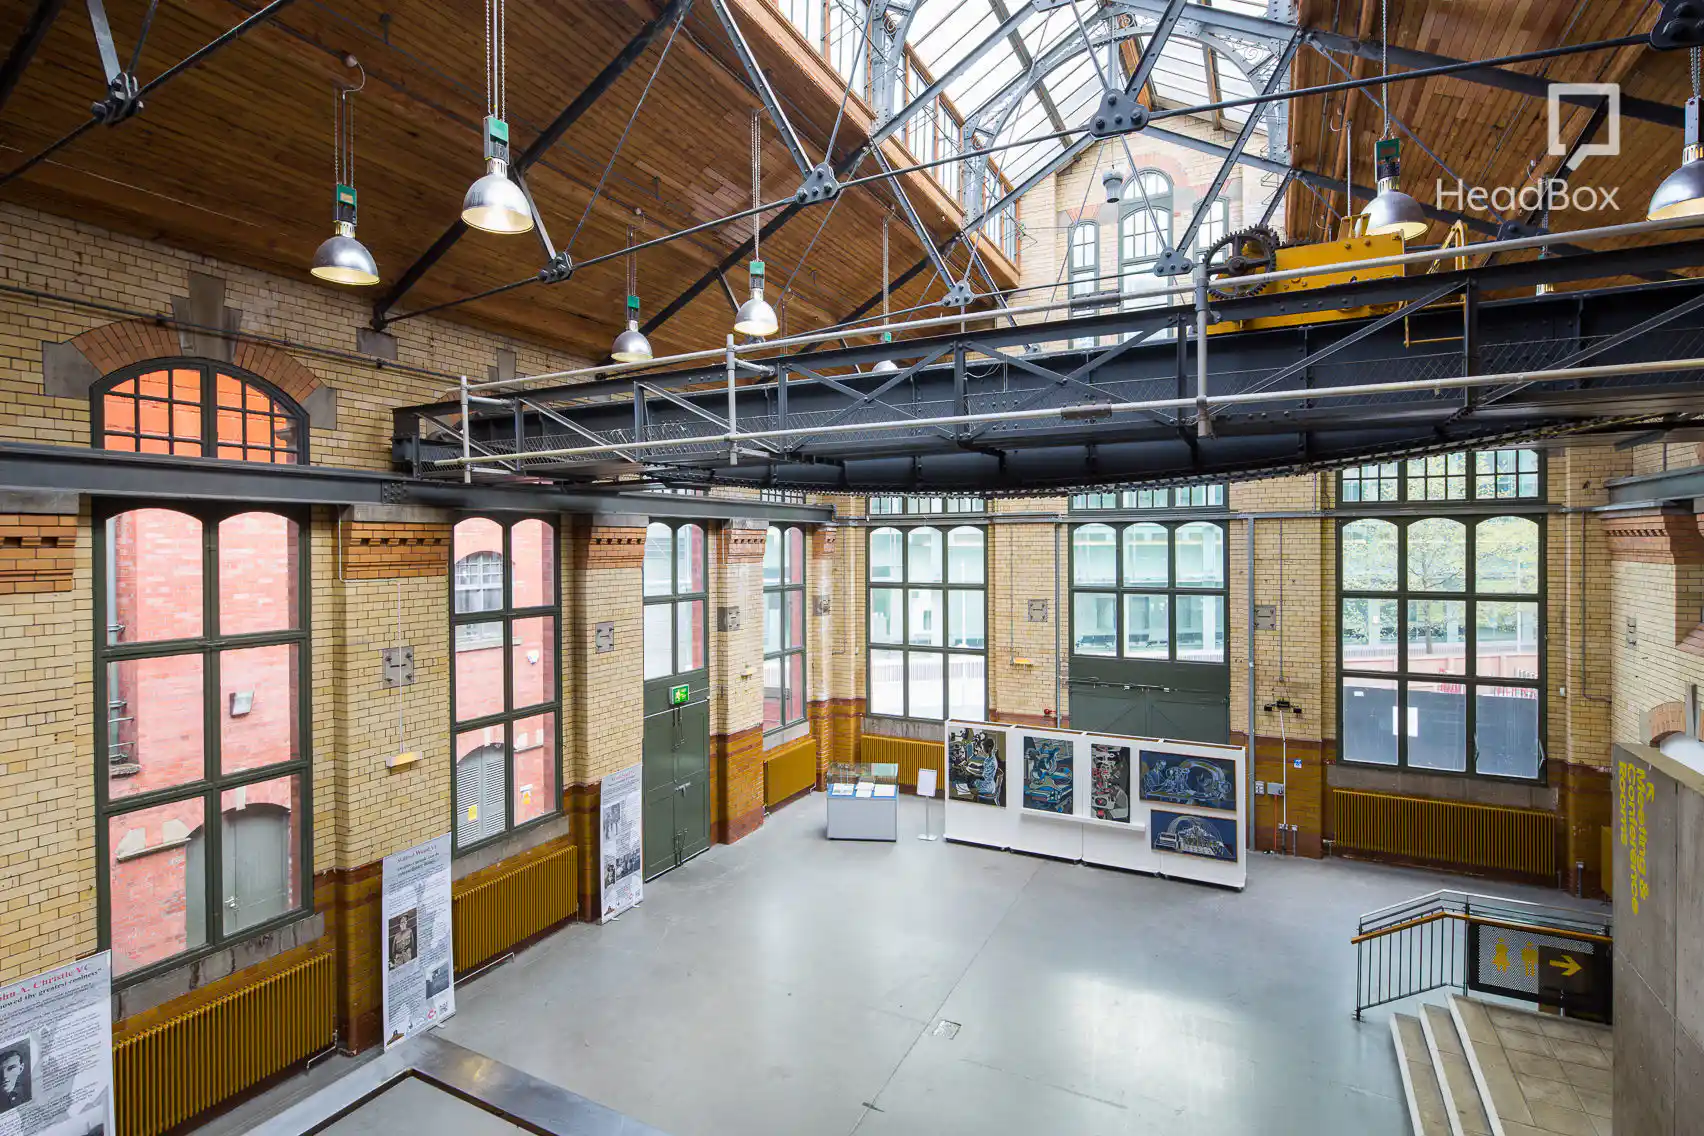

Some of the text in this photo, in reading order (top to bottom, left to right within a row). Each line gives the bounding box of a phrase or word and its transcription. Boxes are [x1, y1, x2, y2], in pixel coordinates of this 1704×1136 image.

[1618, 760, 1627, 846] Rooms
[1627, 763, 1639, 915] Conference
[1636, 767, 1649, 901] Meeting &
[33, 970, 73, 989] Christie
[38, 981, 67, 997] greatest
